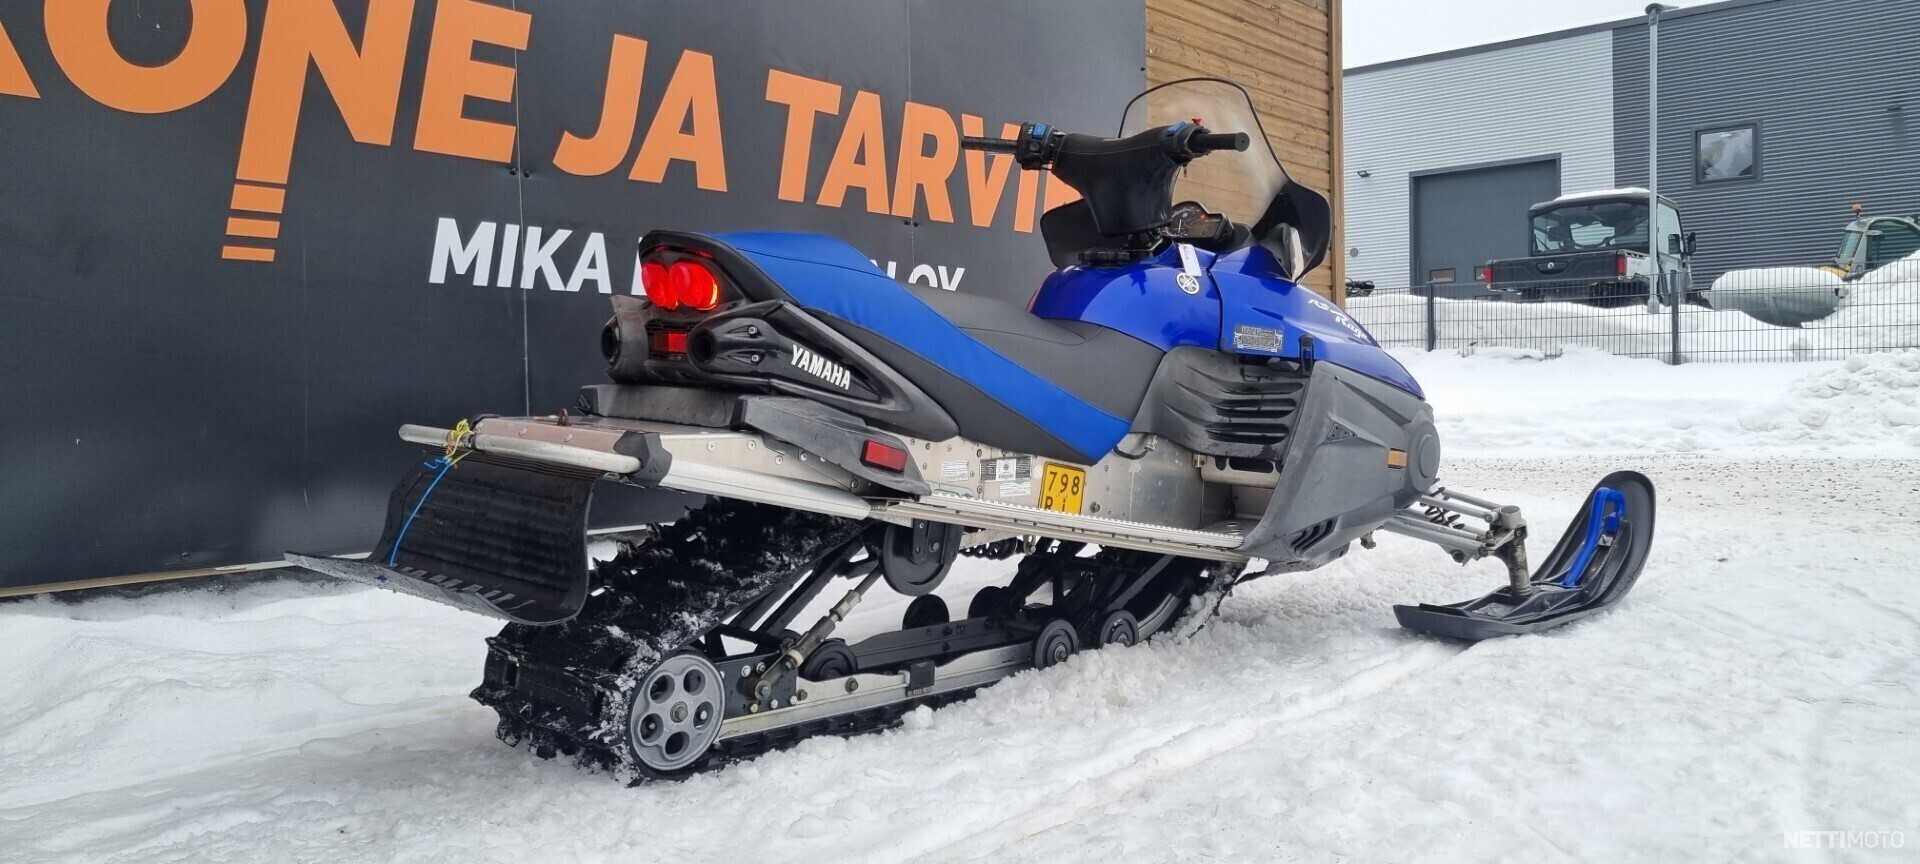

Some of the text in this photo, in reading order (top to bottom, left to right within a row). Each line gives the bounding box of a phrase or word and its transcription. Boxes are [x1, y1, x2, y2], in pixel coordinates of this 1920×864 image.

[0, 0, 532, 184] ONE
[552, 33, 728, 192] JA
[428, 216, 612, 294] MIKA
[790, 343, 850, 391] YAMAHA
[1048, 470, 1080, 496] 798
